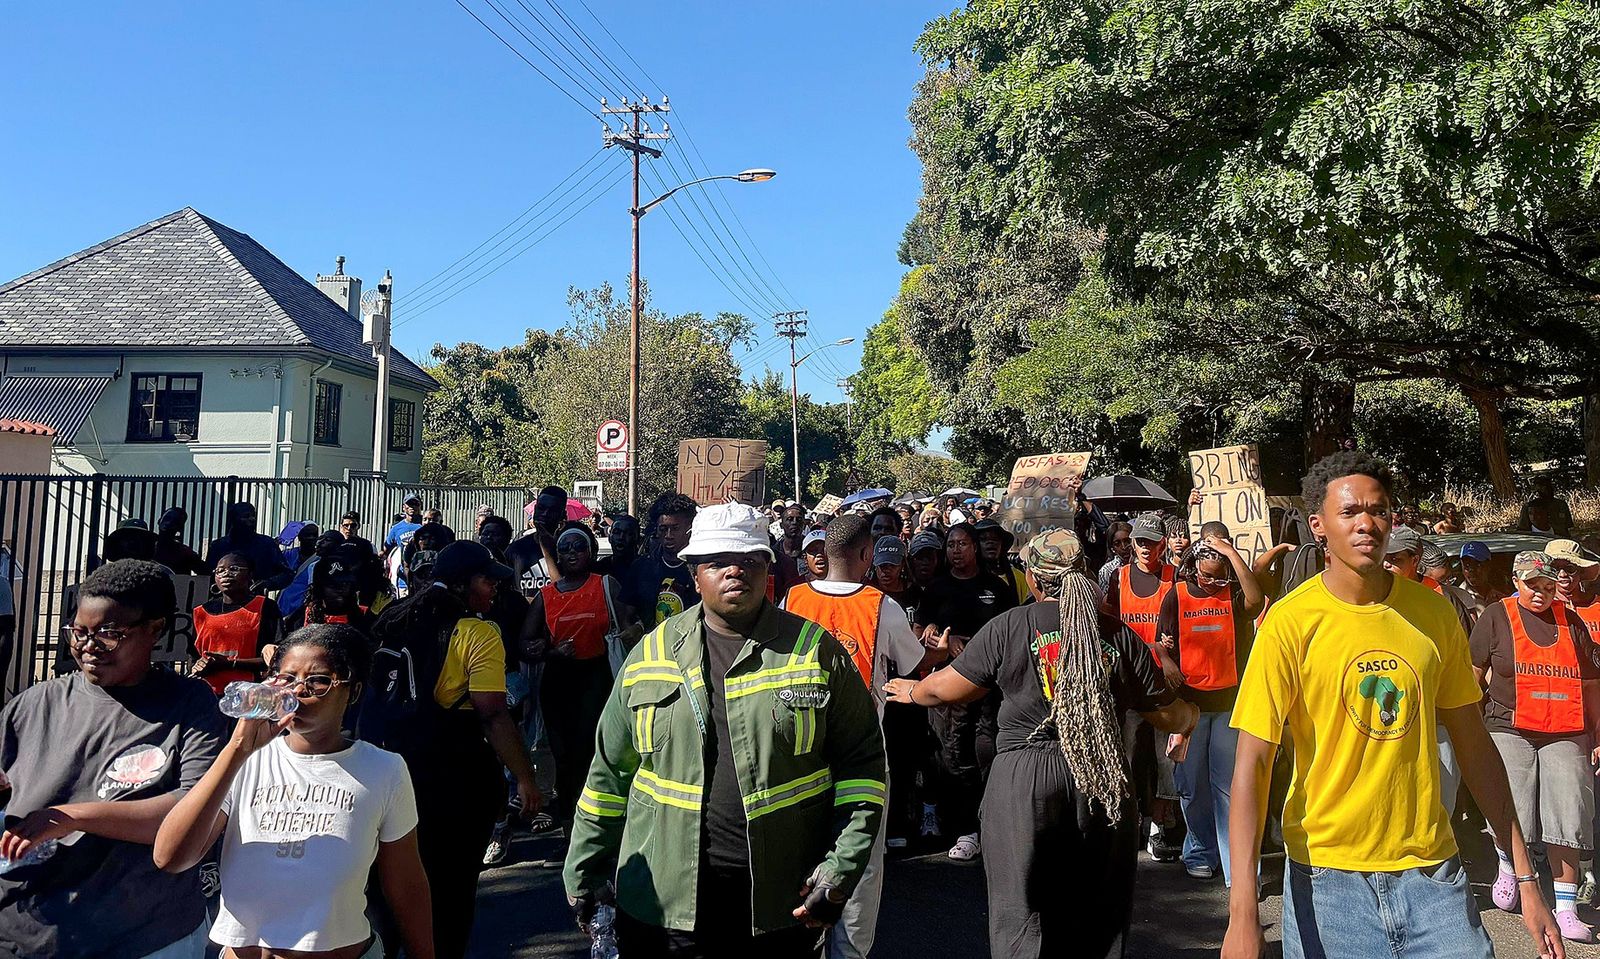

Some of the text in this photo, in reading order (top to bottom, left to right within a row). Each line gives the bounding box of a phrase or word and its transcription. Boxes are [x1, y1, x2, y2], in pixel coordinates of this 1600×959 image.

[606, 428, 620, 445] P
[686, 444, 750, 466] NOT
[1188, 451, 1261, 489] BRING
[717, 469, 764, 494] YET
[1236, 490, 1263, 524] ON
[1183, 608, 1229, 619] MARSHALL
[1357, 659, 1398, 673] SASCO
[1516, 662, 1581, 679] MARSHALL
